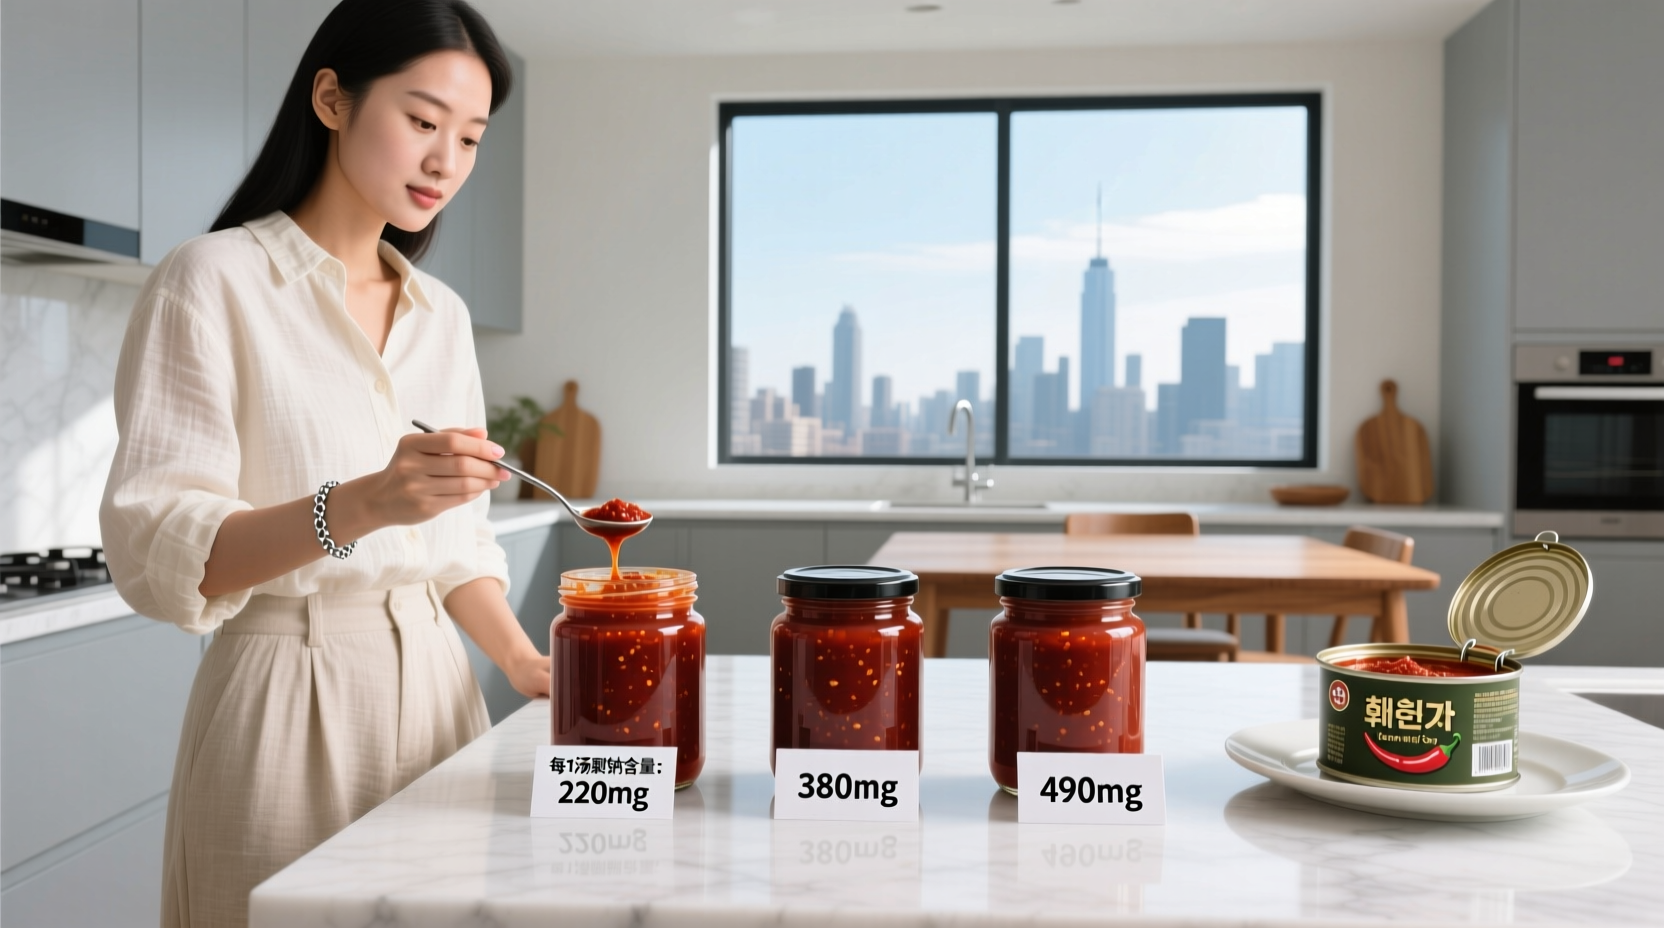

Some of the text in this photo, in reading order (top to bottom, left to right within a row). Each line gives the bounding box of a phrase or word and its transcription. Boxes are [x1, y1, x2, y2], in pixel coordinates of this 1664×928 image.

[558, 780, 649, 812] 220mg
[798, 772, 898, 808] 380mg
[1040, 776, 1142, 812] 490mg
